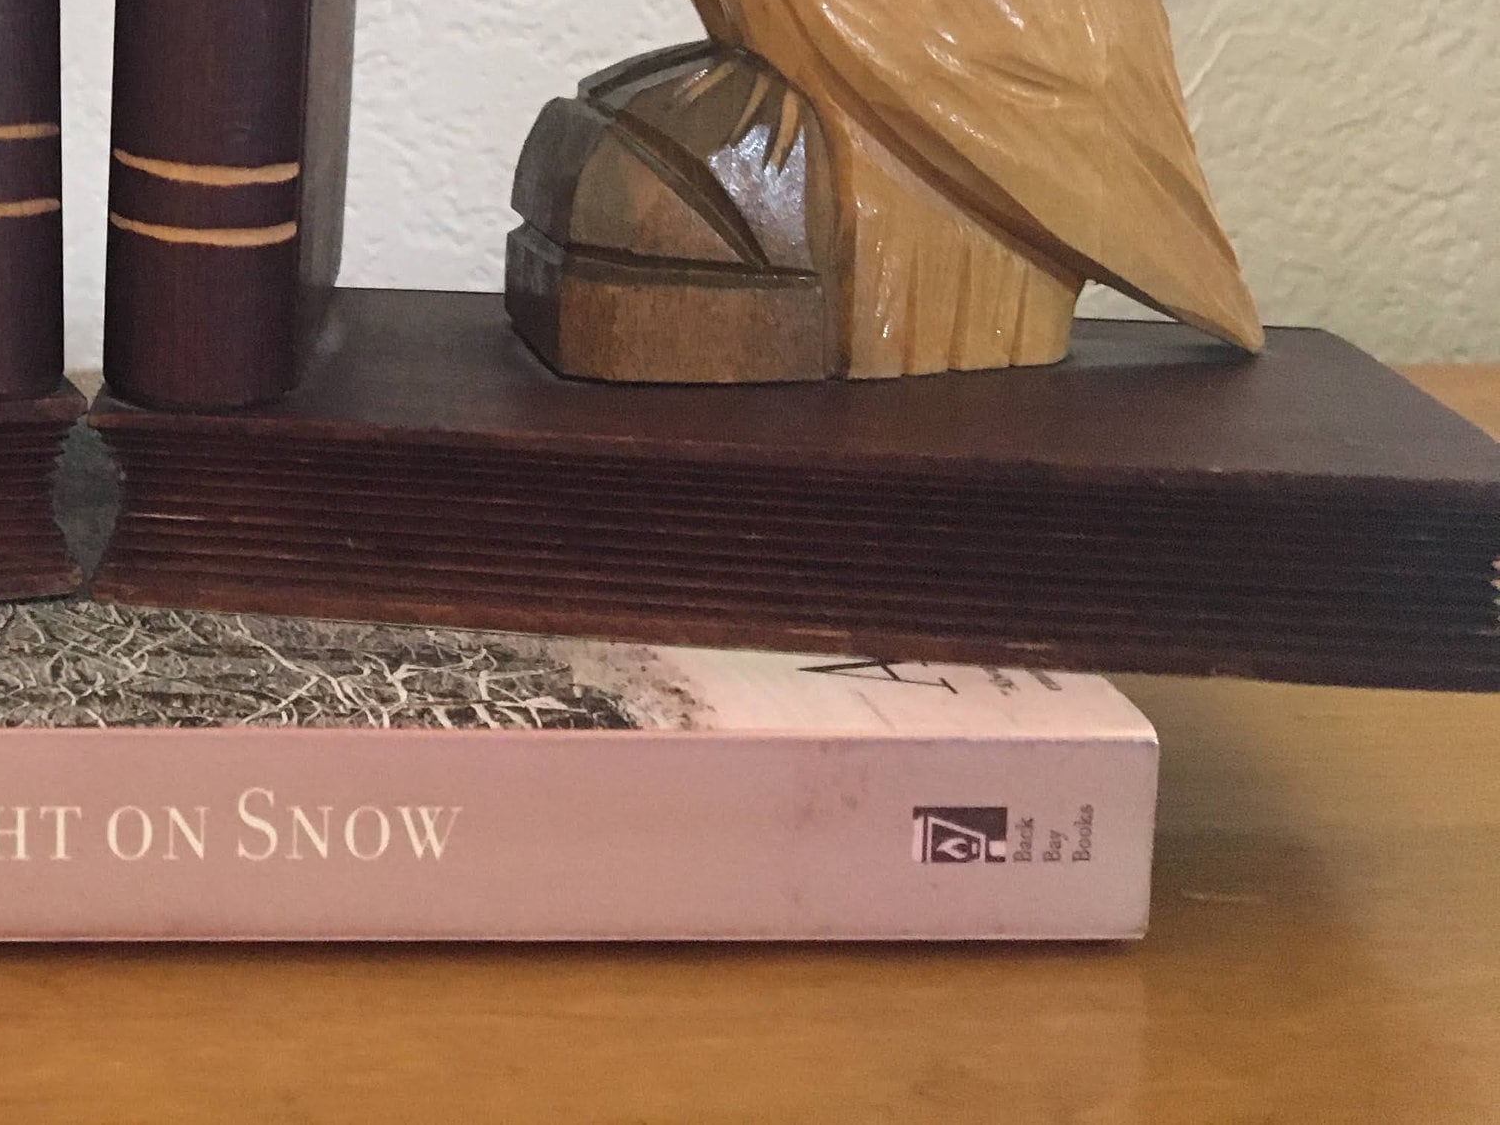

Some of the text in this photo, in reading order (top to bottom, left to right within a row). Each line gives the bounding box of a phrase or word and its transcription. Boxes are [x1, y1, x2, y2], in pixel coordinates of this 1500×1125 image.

[106, 806, 209, 861] ON
[236, 787, 463, 862] SNOW
[1013, 816, 1034, 862] Back
[1043, 829, 1069, 862] Bay
[1072, 803, 1095, 862] Books
